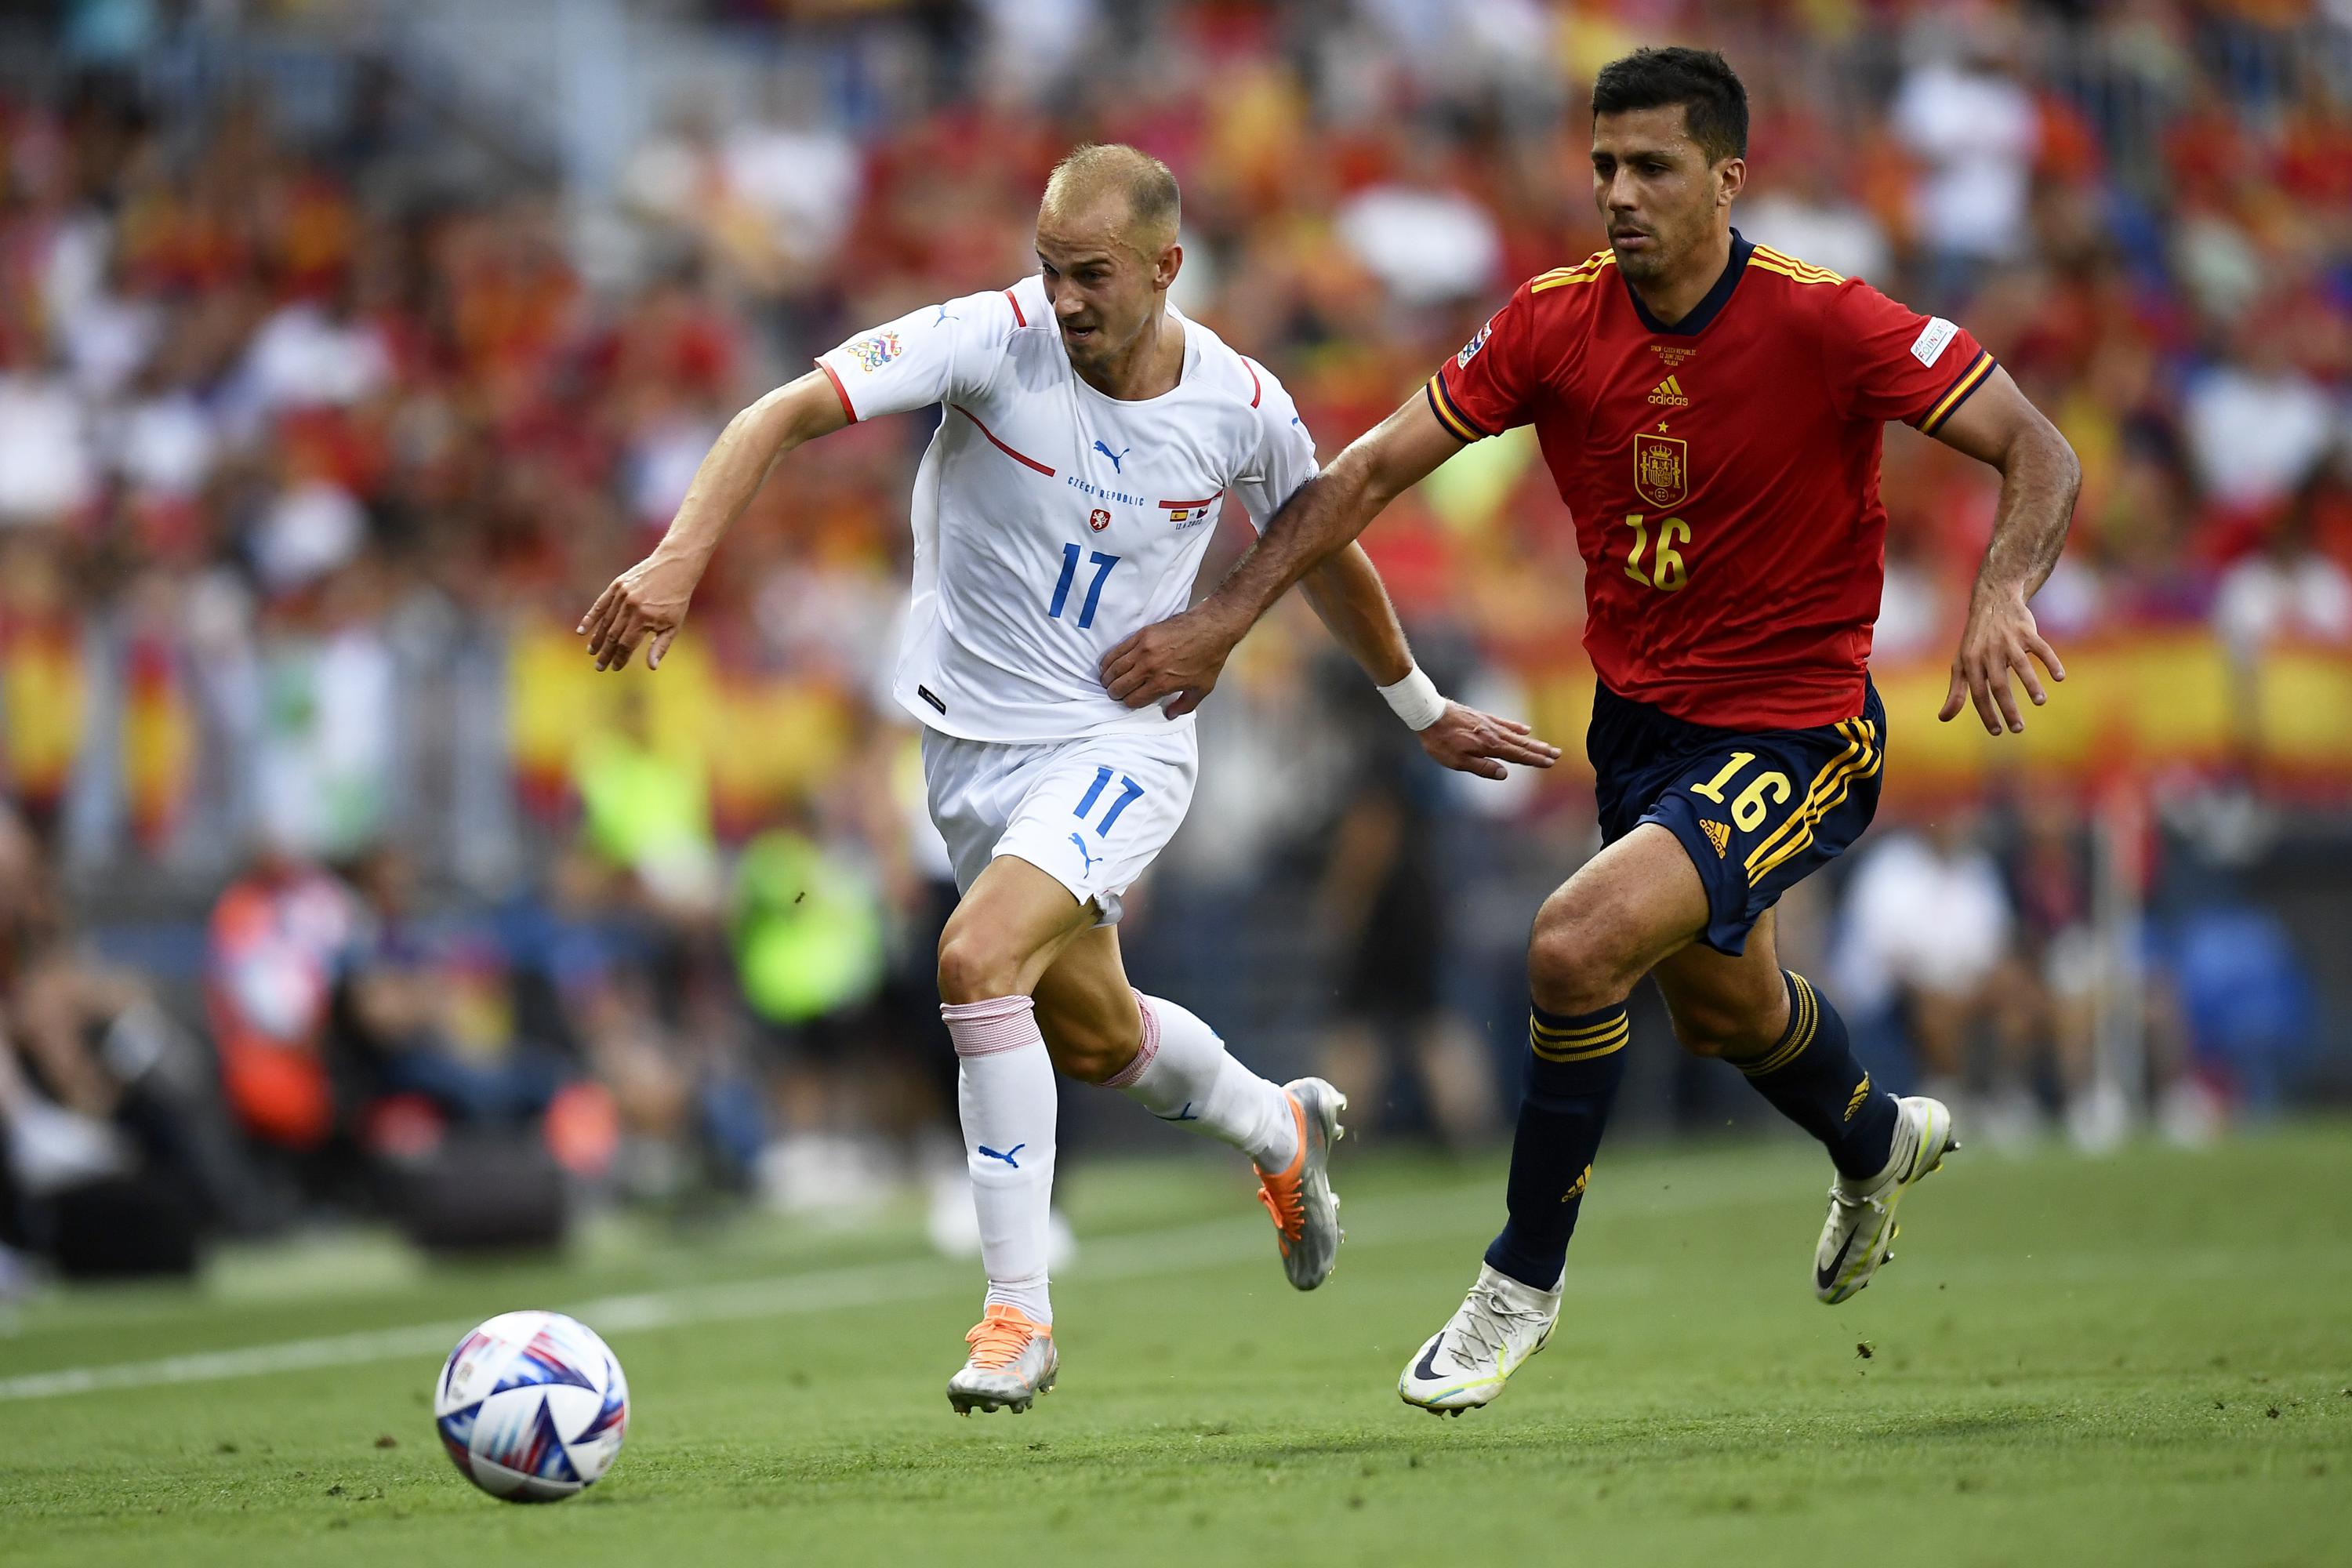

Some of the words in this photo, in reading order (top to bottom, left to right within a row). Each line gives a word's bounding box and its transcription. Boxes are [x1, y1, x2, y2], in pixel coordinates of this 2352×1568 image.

[1647, 394, 1689, 406] adidas
[1068, 477, 1095, 494] CZECH
[1099, 489, 1145, 506] REPUBLIC
[1048, 543, 1121, 629] 17
[1624, 514, 1691, 591] 16
[1073, 767, 1145, 839] 17
[1690, 752, 1791, 833] 16
[1699, 818, 1726, 859] adidas
